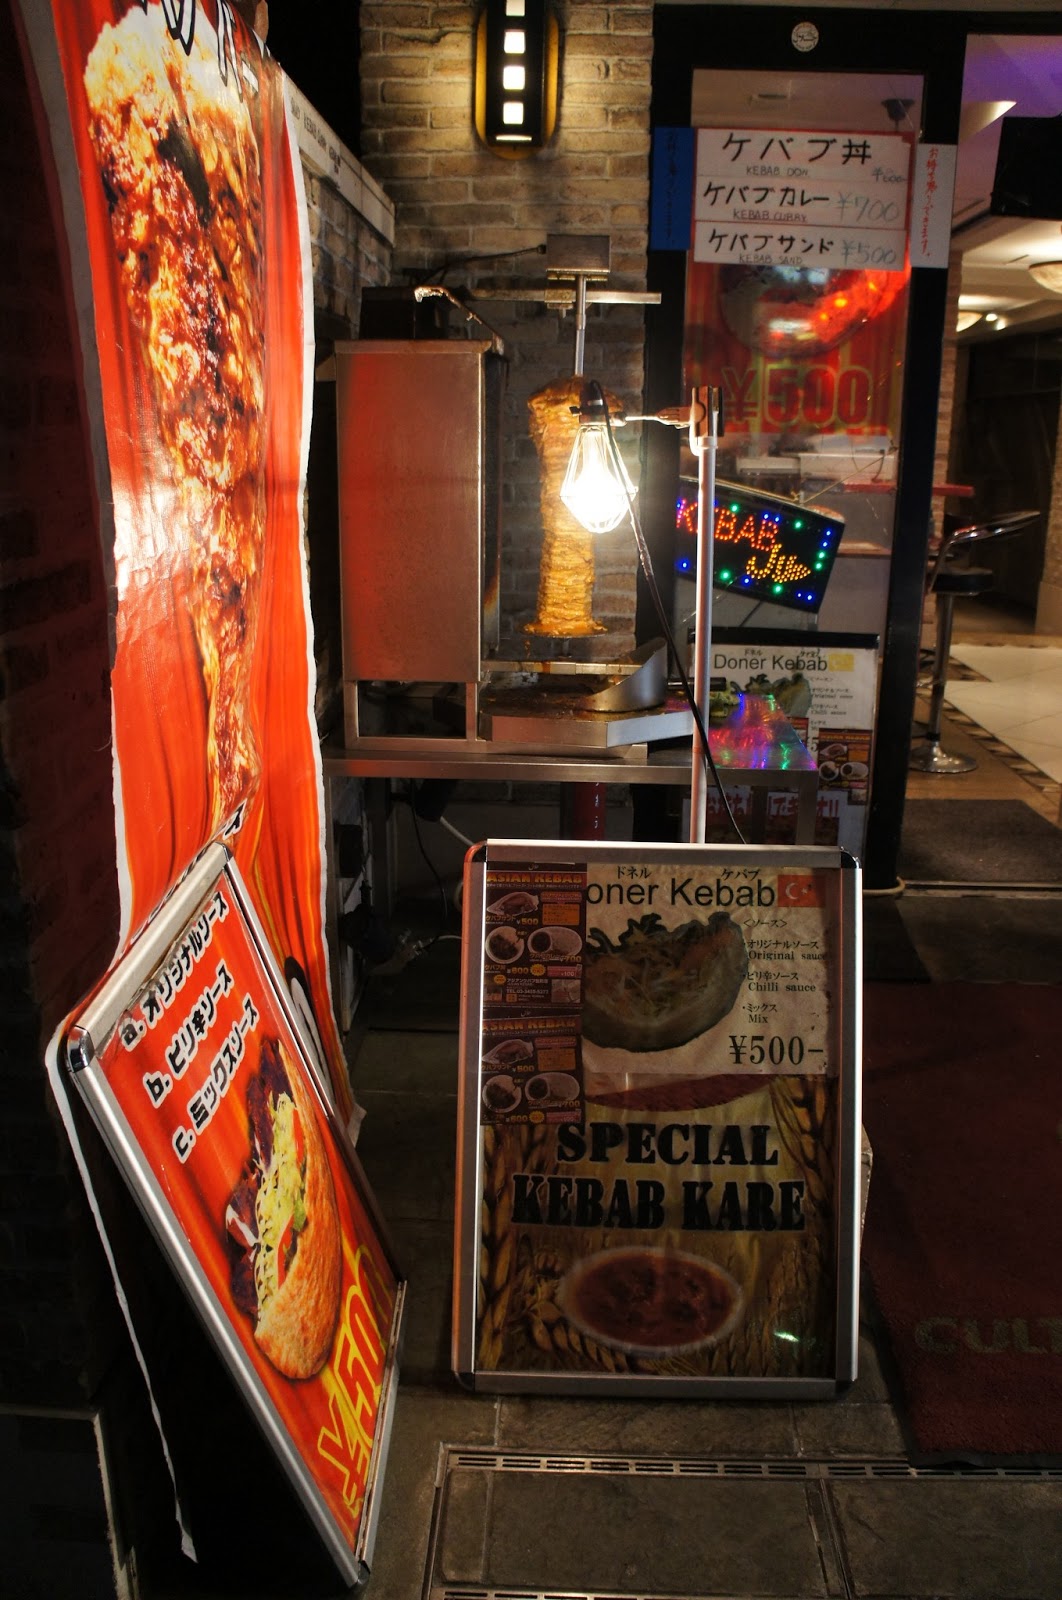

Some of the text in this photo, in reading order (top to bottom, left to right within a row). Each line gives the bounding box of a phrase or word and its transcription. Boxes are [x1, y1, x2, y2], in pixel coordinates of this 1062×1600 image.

[722, 132, 871, 165] ケバブ丼
[746, 165, 780, 176] KEBAB
[704, 181, 830, 207] ケバブカレー
[733, 208, 770, 220] KEBAB
[708, 229, 834, 254] ケバブサンド
[738, 253, 772, 264] KEBAB
[721, 363, 873, 429] ¥500
[676, 498, 779, 552] KBAB
[714, 654, 828, 671] Doner Kebab
[486, 873, 582, 883] ASIAN KEBAB
[617, 865, 761, 881] ドネル ケバブ
[587, 877, 775, 907] oner Kebab
[748, 950, 795, 961] Original
[748, 982, 816, 992] Chilli sauce
[748, 1014, 769, 1024] Mix
[557, 1122, 779, 1166] SPECIAL
[511, 1174, 806, 1231] KEBAB KARE
